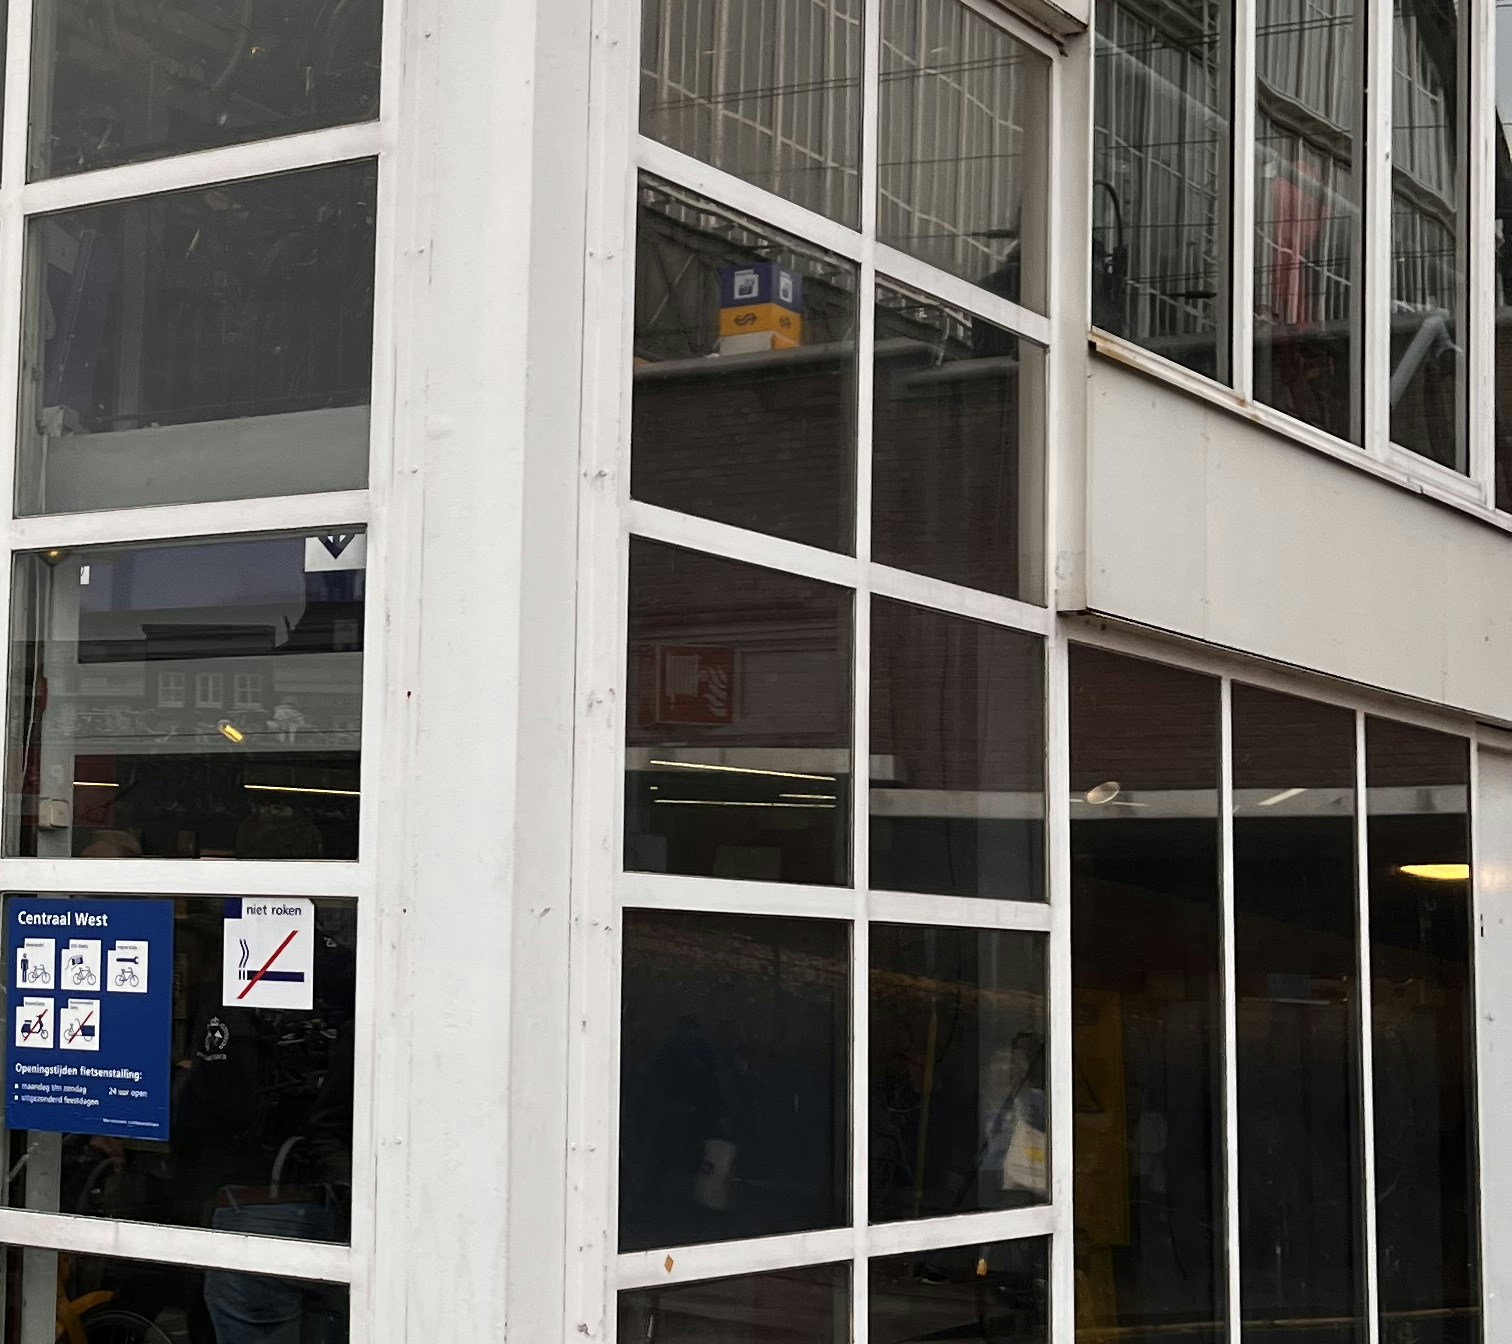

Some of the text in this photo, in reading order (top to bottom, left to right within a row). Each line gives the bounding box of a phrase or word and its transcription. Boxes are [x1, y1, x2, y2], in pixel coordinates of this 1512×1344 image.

[247, 904, 302, 915] niet roken
[18, 911, 108, 927] Centraal West
[15, 1063, 143, 1082] Openingstijden fietsenstalling:
